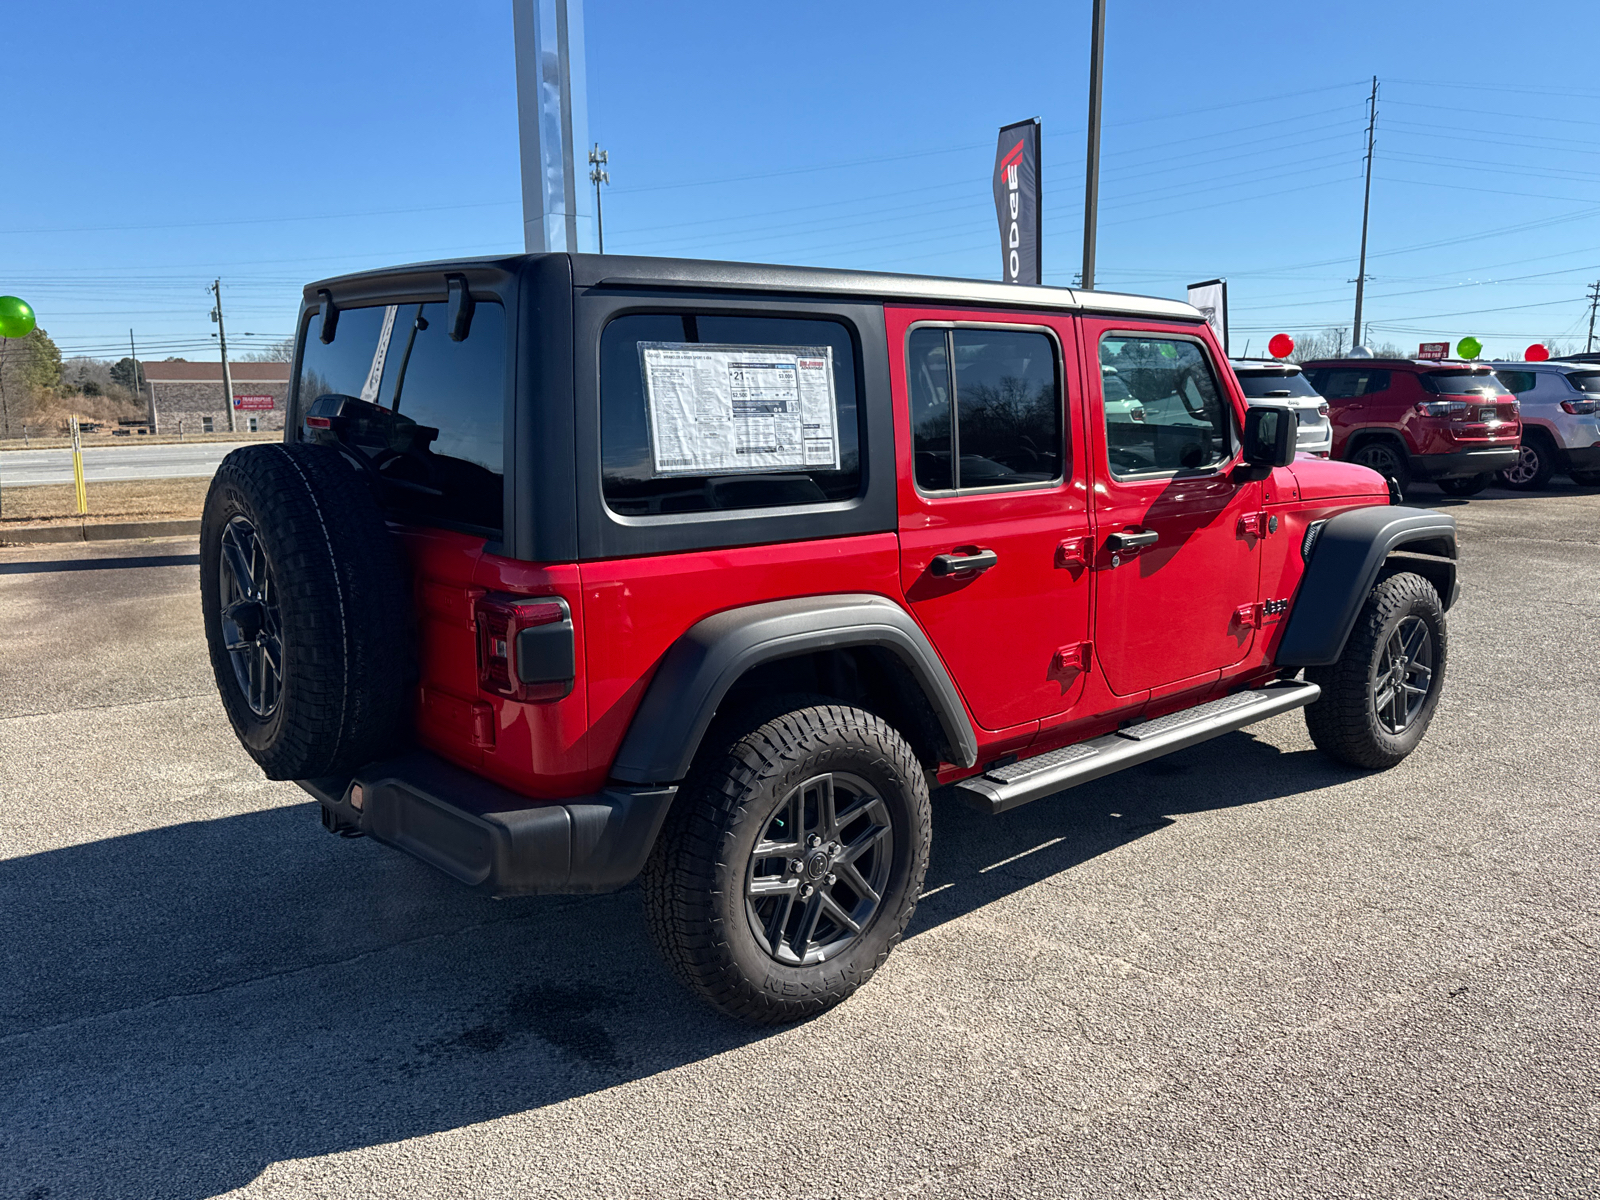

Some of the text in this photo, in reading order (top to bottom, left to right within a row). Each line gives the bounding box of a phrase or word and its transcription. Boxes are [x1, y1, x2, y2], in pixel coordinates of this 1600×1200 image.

[1008, 164, 1019, 282] ODGE
[734, 371, 744, 381] 21
[763, 962, 856, 998] NEXEN
